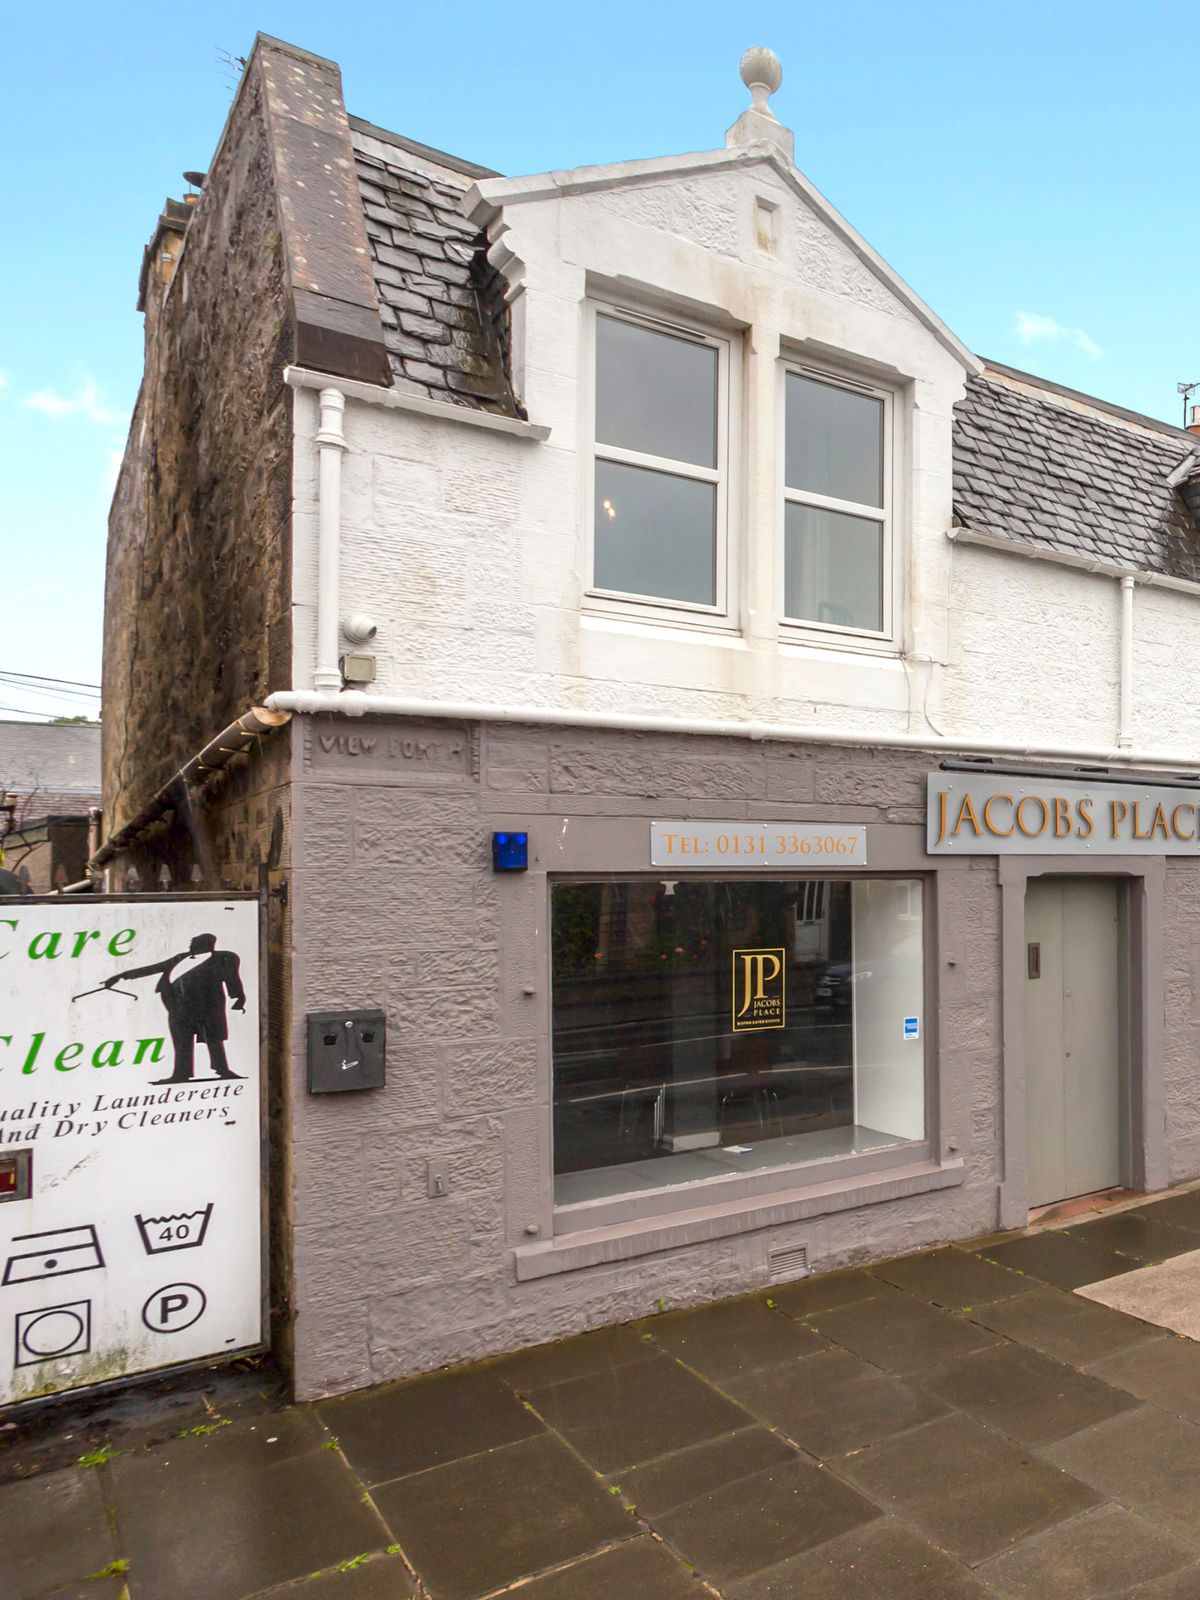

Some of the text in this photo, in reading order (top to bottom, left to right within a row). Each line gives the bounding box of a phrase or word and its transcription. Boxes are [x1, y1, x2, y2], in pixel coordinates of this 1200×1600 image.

[319, 734, 377, 757] VIEW
[935, 790, 1095, 848] JACOBS
[716, 834, 766, 855] 0131
[775, 834, 858, 855] 3363067
[737, 954, 781, 1018] JP
[753, 999, 781, 1009] JACOBS
[753, 1008, 781, 1017] PLACE
[92, 1084, 244, 1112] Launderette
[53, 1119, 108, 1138] Dry
[118, 1105, 230, 1130] Cleaners
[158, 1224, 190, 1242] 40
[160, 1293, 189, 1324] P
